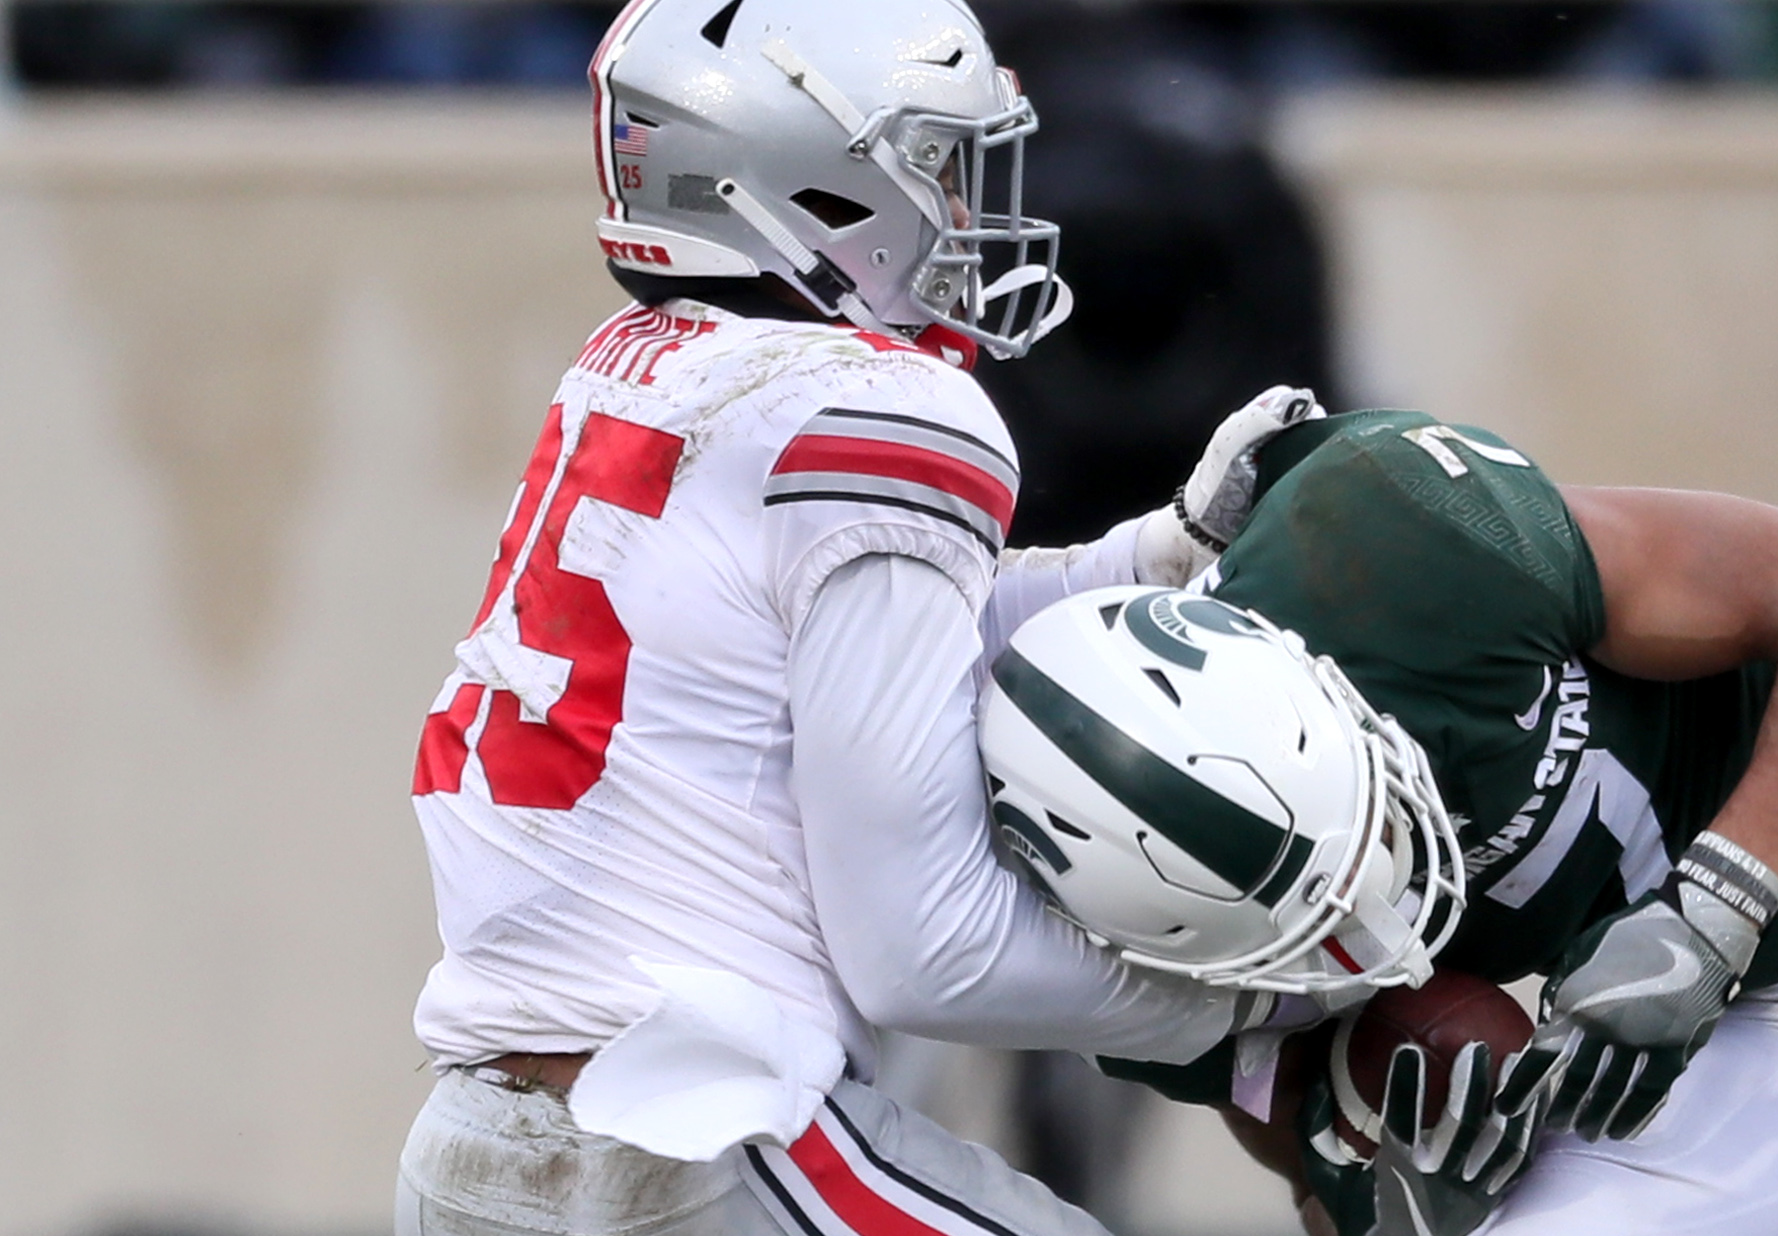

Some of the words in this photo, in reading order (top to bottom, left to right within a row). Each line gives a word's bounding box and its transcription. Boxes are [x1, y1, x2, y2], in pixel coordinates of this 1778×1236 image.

[620, 164, 642, 189] 25
[1484, 748, 1676, 909] 7
[1715, 881, 1747, 907] JUST
